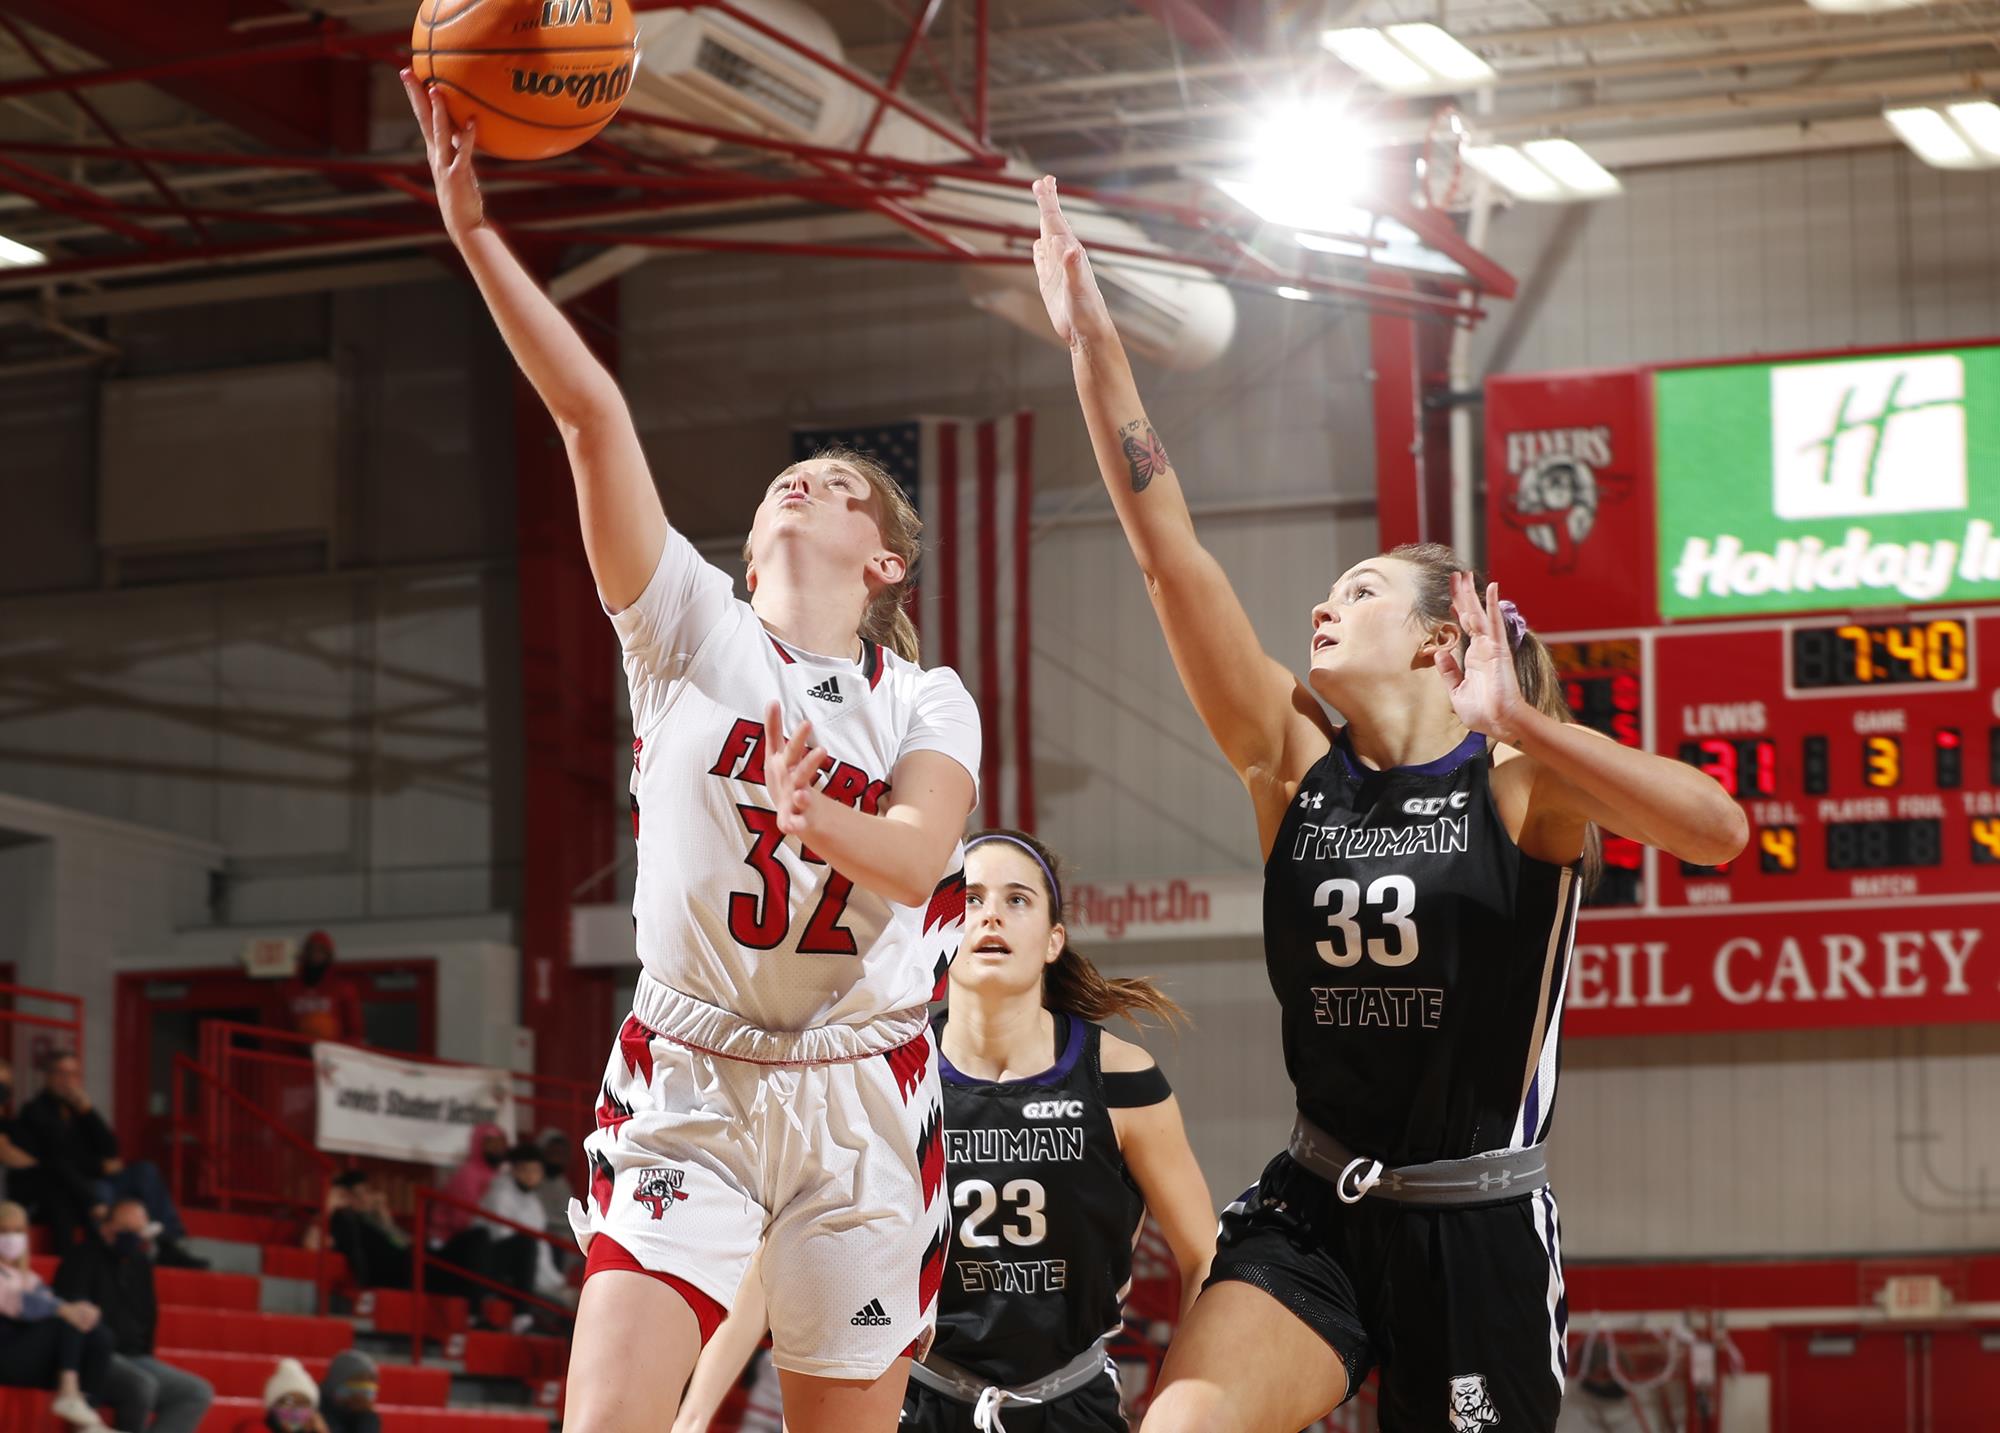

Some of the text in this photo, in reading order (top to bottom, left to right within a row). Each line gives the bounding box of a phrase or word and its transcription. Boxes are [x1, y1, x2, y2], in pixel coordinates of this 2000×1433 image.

[512, 62, 630, 109] Wilson
[1506, 426, 1612, 474] FLYERS
[1673, 527, 1957, 600] Holiday
[1837, 619, 1966, 682] 7:40
[806, 689, 844, 704] adidas
[1684, 702, 1768, 735] LEWIS
[1854, 710, 1906, 734] GAME
[1702, 739, 1776, 795] 31
[1868, 737, 1899, 787] 3
[1818, 795, 1945, 821] PLAYER FOUL
[1292, 813, 1469, 861] TRUMAN
[1761, 828, 1796, 869] 4
[728, 803, 858, 955] 32
[1851, 876, 1918, 897] MATCH
[1313, 874, 1420, 968] 33
[1567, 929, 1982, 1009] EIL CAREY
[1310, 987, 1444, 1029] STATE
[1022, 1100, 1084, 1119] GLVC
[944, 1127, 1084, 1163] RUMAN
[638, 1168, 685, 1189] FLYERS
[953, 1178, 1047, 1248] 23
[956, 1259, 1066, 1294] STATE
[851, 1315, 892, 1326] adidas
